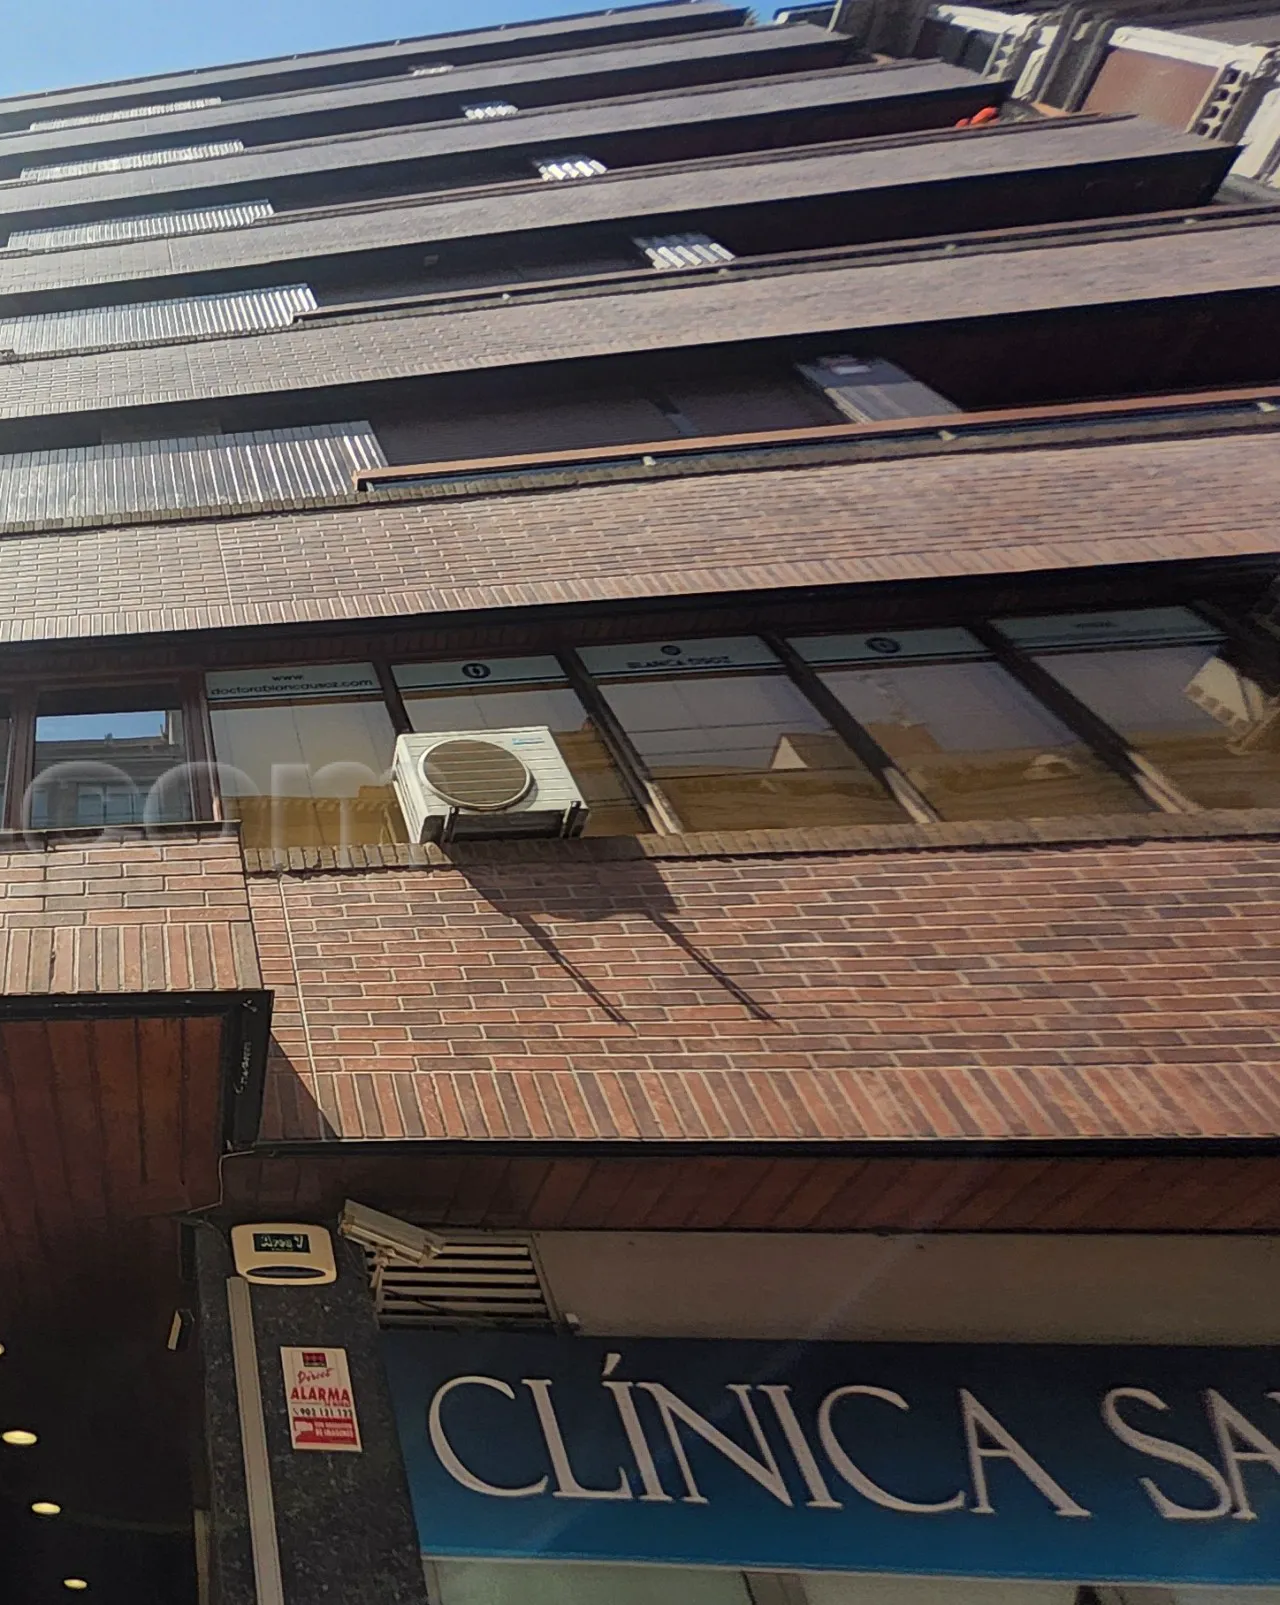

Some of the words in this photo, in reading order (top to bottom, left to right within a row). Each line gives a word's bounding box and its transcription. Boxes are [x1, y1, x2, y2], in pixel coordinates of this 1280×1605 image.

[290, 1386, 351, 1402] ALARMA
[427, 1352, 1092, 1519] CLÍNICA
[1101, 1387, 1280, 1520] SA
